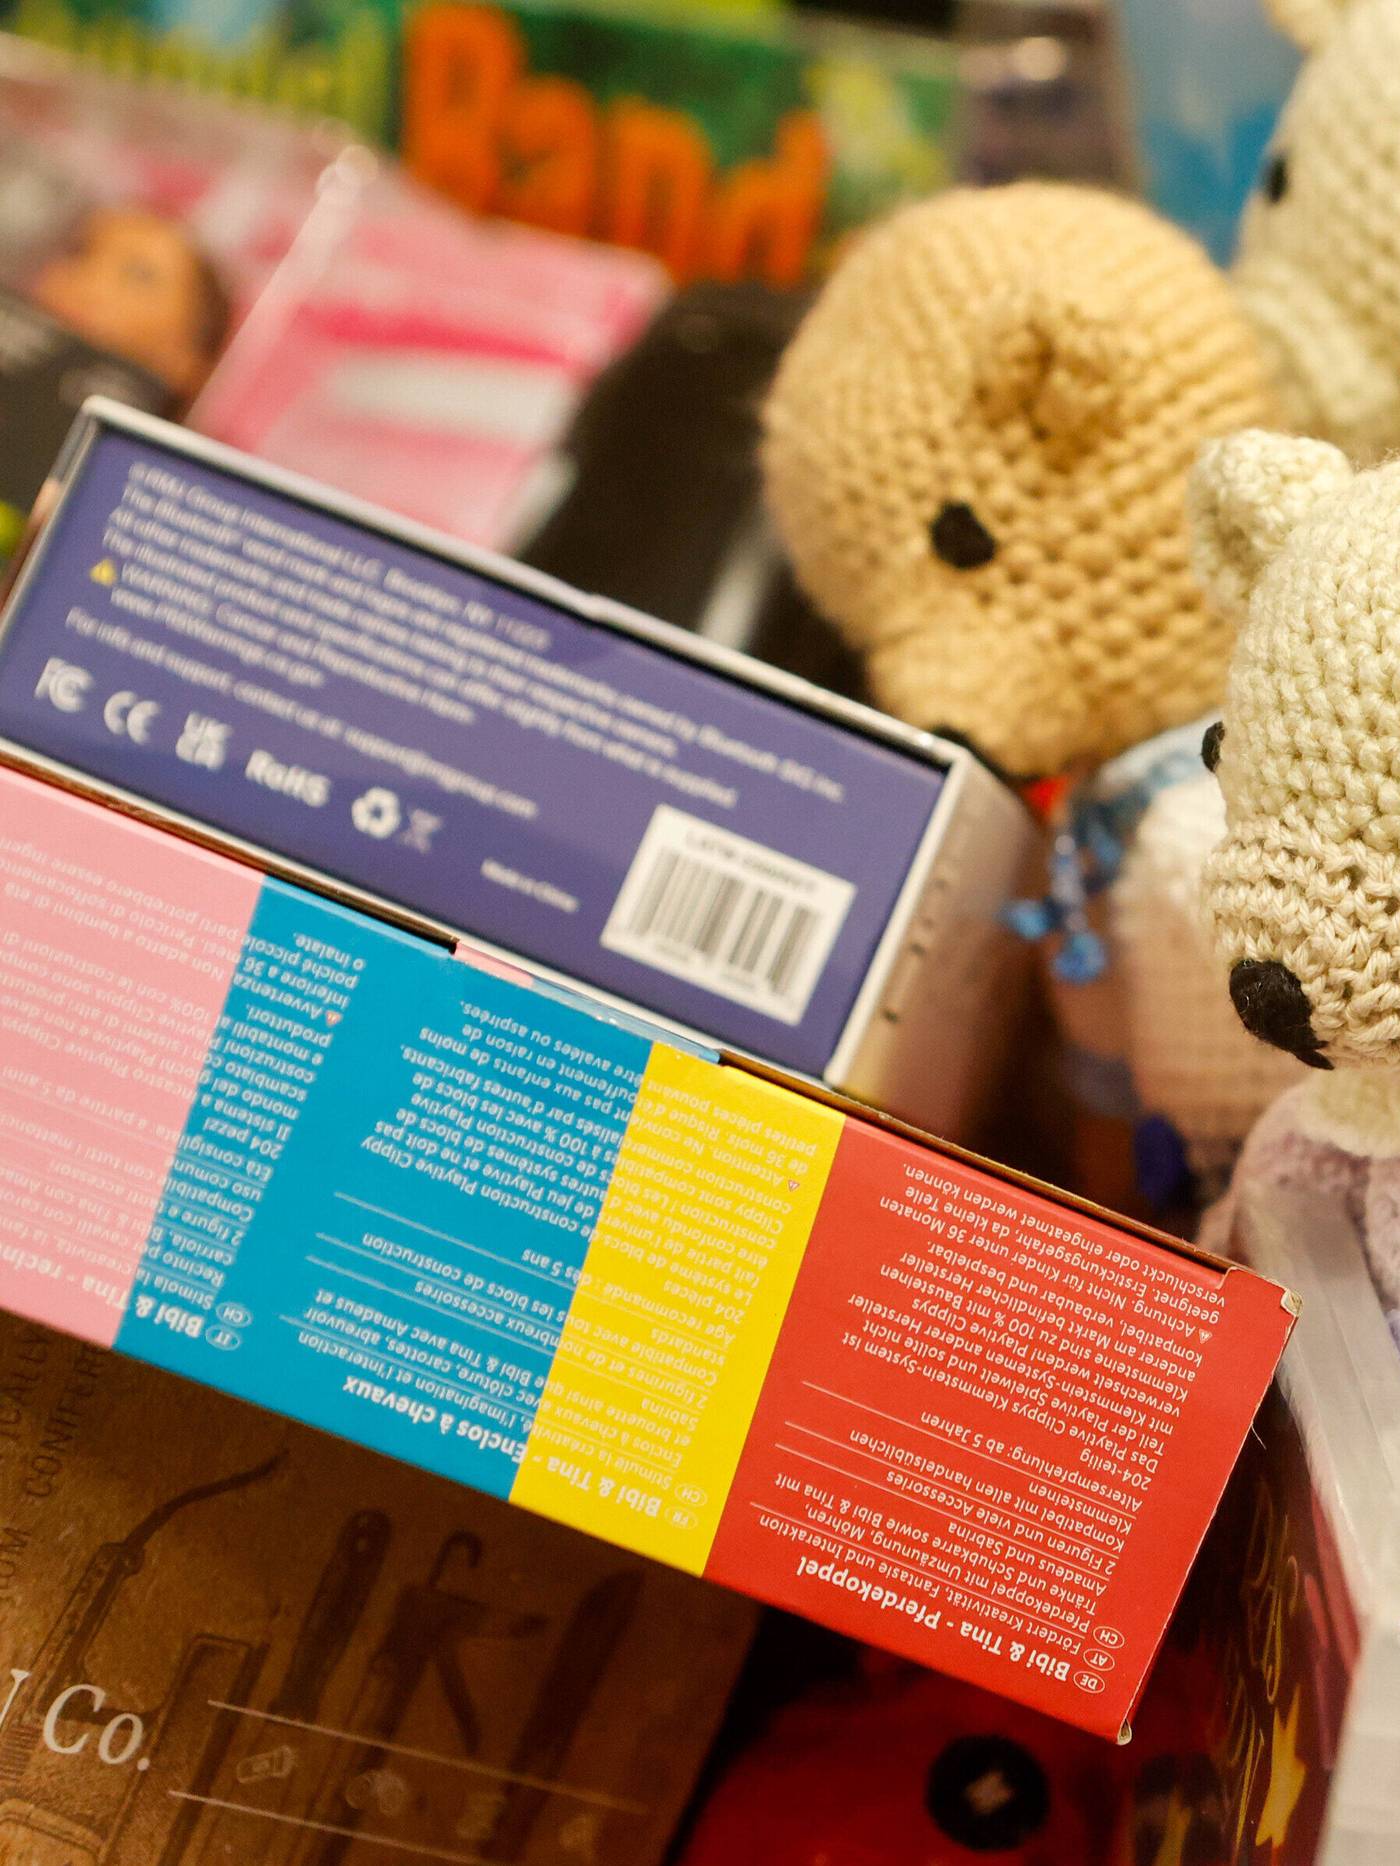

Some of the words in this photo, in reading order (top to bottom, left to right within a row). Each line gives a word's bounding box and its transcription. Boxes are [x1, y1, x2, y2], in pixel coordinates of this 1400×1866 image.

[245, 748, 334, 810] RoHS
[293, 933, 352, 969] inalate.
[351, 957, 367, 972] o
[245, 1003, 334, 1049] produttori.
[459, 1000, 529, 1038] aspirées.
[529, 1030, 553, 1047] ou
[553, 1039, 612, 1072] avalées
[613, 1064, 647, 1091] être
[646, 1079, 713, 1115] pouvant
[202, 1116, 252, 1144] pezzi
[712, 1105, 764, 1135] pièces
[249, 1135, 285, 1160] 204
[763, 1126, 819, 1158] petites
[902, 1163, 962, 1200] können.
[167, 1204, 181, 1219] e
[879, 1195, 947, 1235] Monaten
[904, 1185, 940, 1213] Teile
[963, 1189, 1018, 1221] werden
[180, 1210, 232, 1244] figure
[942, 1201, 990, 1232] kleine
[991, 1221, 1011, 1239] da
[230, 1229, 246, 1248] 2
[946, 1224, 968, 1244] 36
[968, 1233, 1010, 1259] unter
[1019, 1213, 1104, 1256] eingeatmet
[0, 1244, 65, 1280] recin
[1010, 1251, 1061, 1283] Kinder
[1014, 1228, 1148, 1299] Erstickungsgefahr,
[1104, 1250, 1141, 1272] oder
[80, 1273, 132, 1312] Tina
[662, 1279, 716, 1309] pièces
[1061, 1272, 1085, 1293] für
[1086, 1281, 1128, 1311] Nicht
[1141, 1263, 1226, 1308] verschluckt
[134, 1293, 158, 1319] &
[221, 1304, 246, 1324] CH
[414, 1279, 506, 1325] accessoires
[713, 1301, 747, 1326] 204
[847, 1293, 923, 1335] Hersteller
[1131, 1298, 1197, 1338] Achtung.
[1151, 1287, 1221, 1325] geeignet.
[153, 1302, 206, 1339] Bibi
[505, 1316, 586, 1358] nombreux
[862, 1319, 903, 1344] nicht
[297, 1328, 396, 1380] l'interaction
[841, 1331, 862, 1352] ist
[903, 1336, 947, 1362] sollte
[923, 1324, 984, 1357] anderer
[585, 1349, 608, 1368] de
[607, 1359, 627, 1374] et
[946, 1353, 979, 1375] und
[394, 1367, 415, 1385] et
[627, 1366, 697, 1405] figurines
[863, 1340, 1010, 1412] Klemmstein-System
[979, 1367, 1049, 1408] Spielwelt
[985, 1349, 1148, 1427] Klemmstein-Systemen
[341, 1375, 438, 1425] chevaux
[414, 1376, 518, 1430] l'imagination
[695, 1394, 709, 1410] 2
[1050, 1396, 1110, 1433] Playtive
[24, 1343, 109, 1501] CONIFER
[438, 1412, 456, 1435] à
[920, 1411, 972, 1444] Jahren
[1011, 1401, 1067, 1436] Clippys
[1111, 1422, 1138, 1442] der
[1147, 1416, 1174, 1436] mit
[455, 1419, 530, 1467] Enclos
[520, 1415, 597, 1457] créativité,
[971, 1432, 984, 1449] 5
[985, 1438, 1006, 1454] ab
[1068, 1425, 1128, 1462] Playtive
[1138, 1432, 1165, 1457] Teil
[546, 1455, 594, 1492] Tina
[597, 1448, 613, 1468] la
[613, 1455, 674, 1491] Stimule
[849, 1429, 973, 1492] handelsüblichen
[1079, 1447, 1153, 1492] 204-teilig
[1129, 1450, 1159, 1474] Das
[598, 1475, 617, 1499] &
[680, 1485, 703, 1505] CH
[774, 1472, 802, 1493] mit
[885, 1470, 975, 1517] Accessories
[974, 1480, 1013, 1505] allen
[1006, 1445, 1144, 1513] Altersempfehlung:
[615, 1484, 663, 1518] Bibi
[803, 1483, 835, 1511] Tina
[839, 1498, 852, 1515] &
[1013, 1495, 1040, 1516] mit
[1028, 1481, 1133, 1536] Klemmsteinen
[804, 1503, 867, 1542] Möhren,
[851, 1504, 884, 1529] Bibi
[885, 1517, 930, 1544] sowie
[975, 1507, 1012, 1531] viele
[1012, 1522, 1045, 1543] und
[1039, 1507, 1126, 1554] Kompatibel
[758, 1514, 844, 1560] Interaktion
[947, 1521, 1004, 1557] Sabrina
[1046, 1535, 1104, 1571] Figuren
[843, 1548, 876, 1569] und
[869, 1529, 962, 1581] Umzäunung,
[931, 1536, 1016, 1582] Schubkarre
[1004, 1544, 1036, 1566] und
[1104, 1559, 1117, 1576] 2
[795, 1555, 942, 1631] Pferdekoppel
[877, 1561, 941, 1599] Fantasie
[963, 1570, 990, 1589] mit
[1015, 1570, 1048, 1591] und
[1037, 1558, 1108, 1597] Amadeus
[944, 1586, 1025, 1633] Kreativität,
[990, 1581, 1091, 1634] Pferdekoppel
[1049, 1583, 1097, 1617] Tränke
[959, 1620, 1003, 1656] Tina
[1008, 1640, 1026, 1663] &
[1025, 1621, 1082, 1656] Fördert
[1098, 1626, 1121, 1646] CH
[1025, 1649, 1072, 1682] Bibi
[1090, 1650, 1109, 1668] AT
[1079, 1671, 1100, 1691] DE
[41, 1682, 152, 1774] Co.
